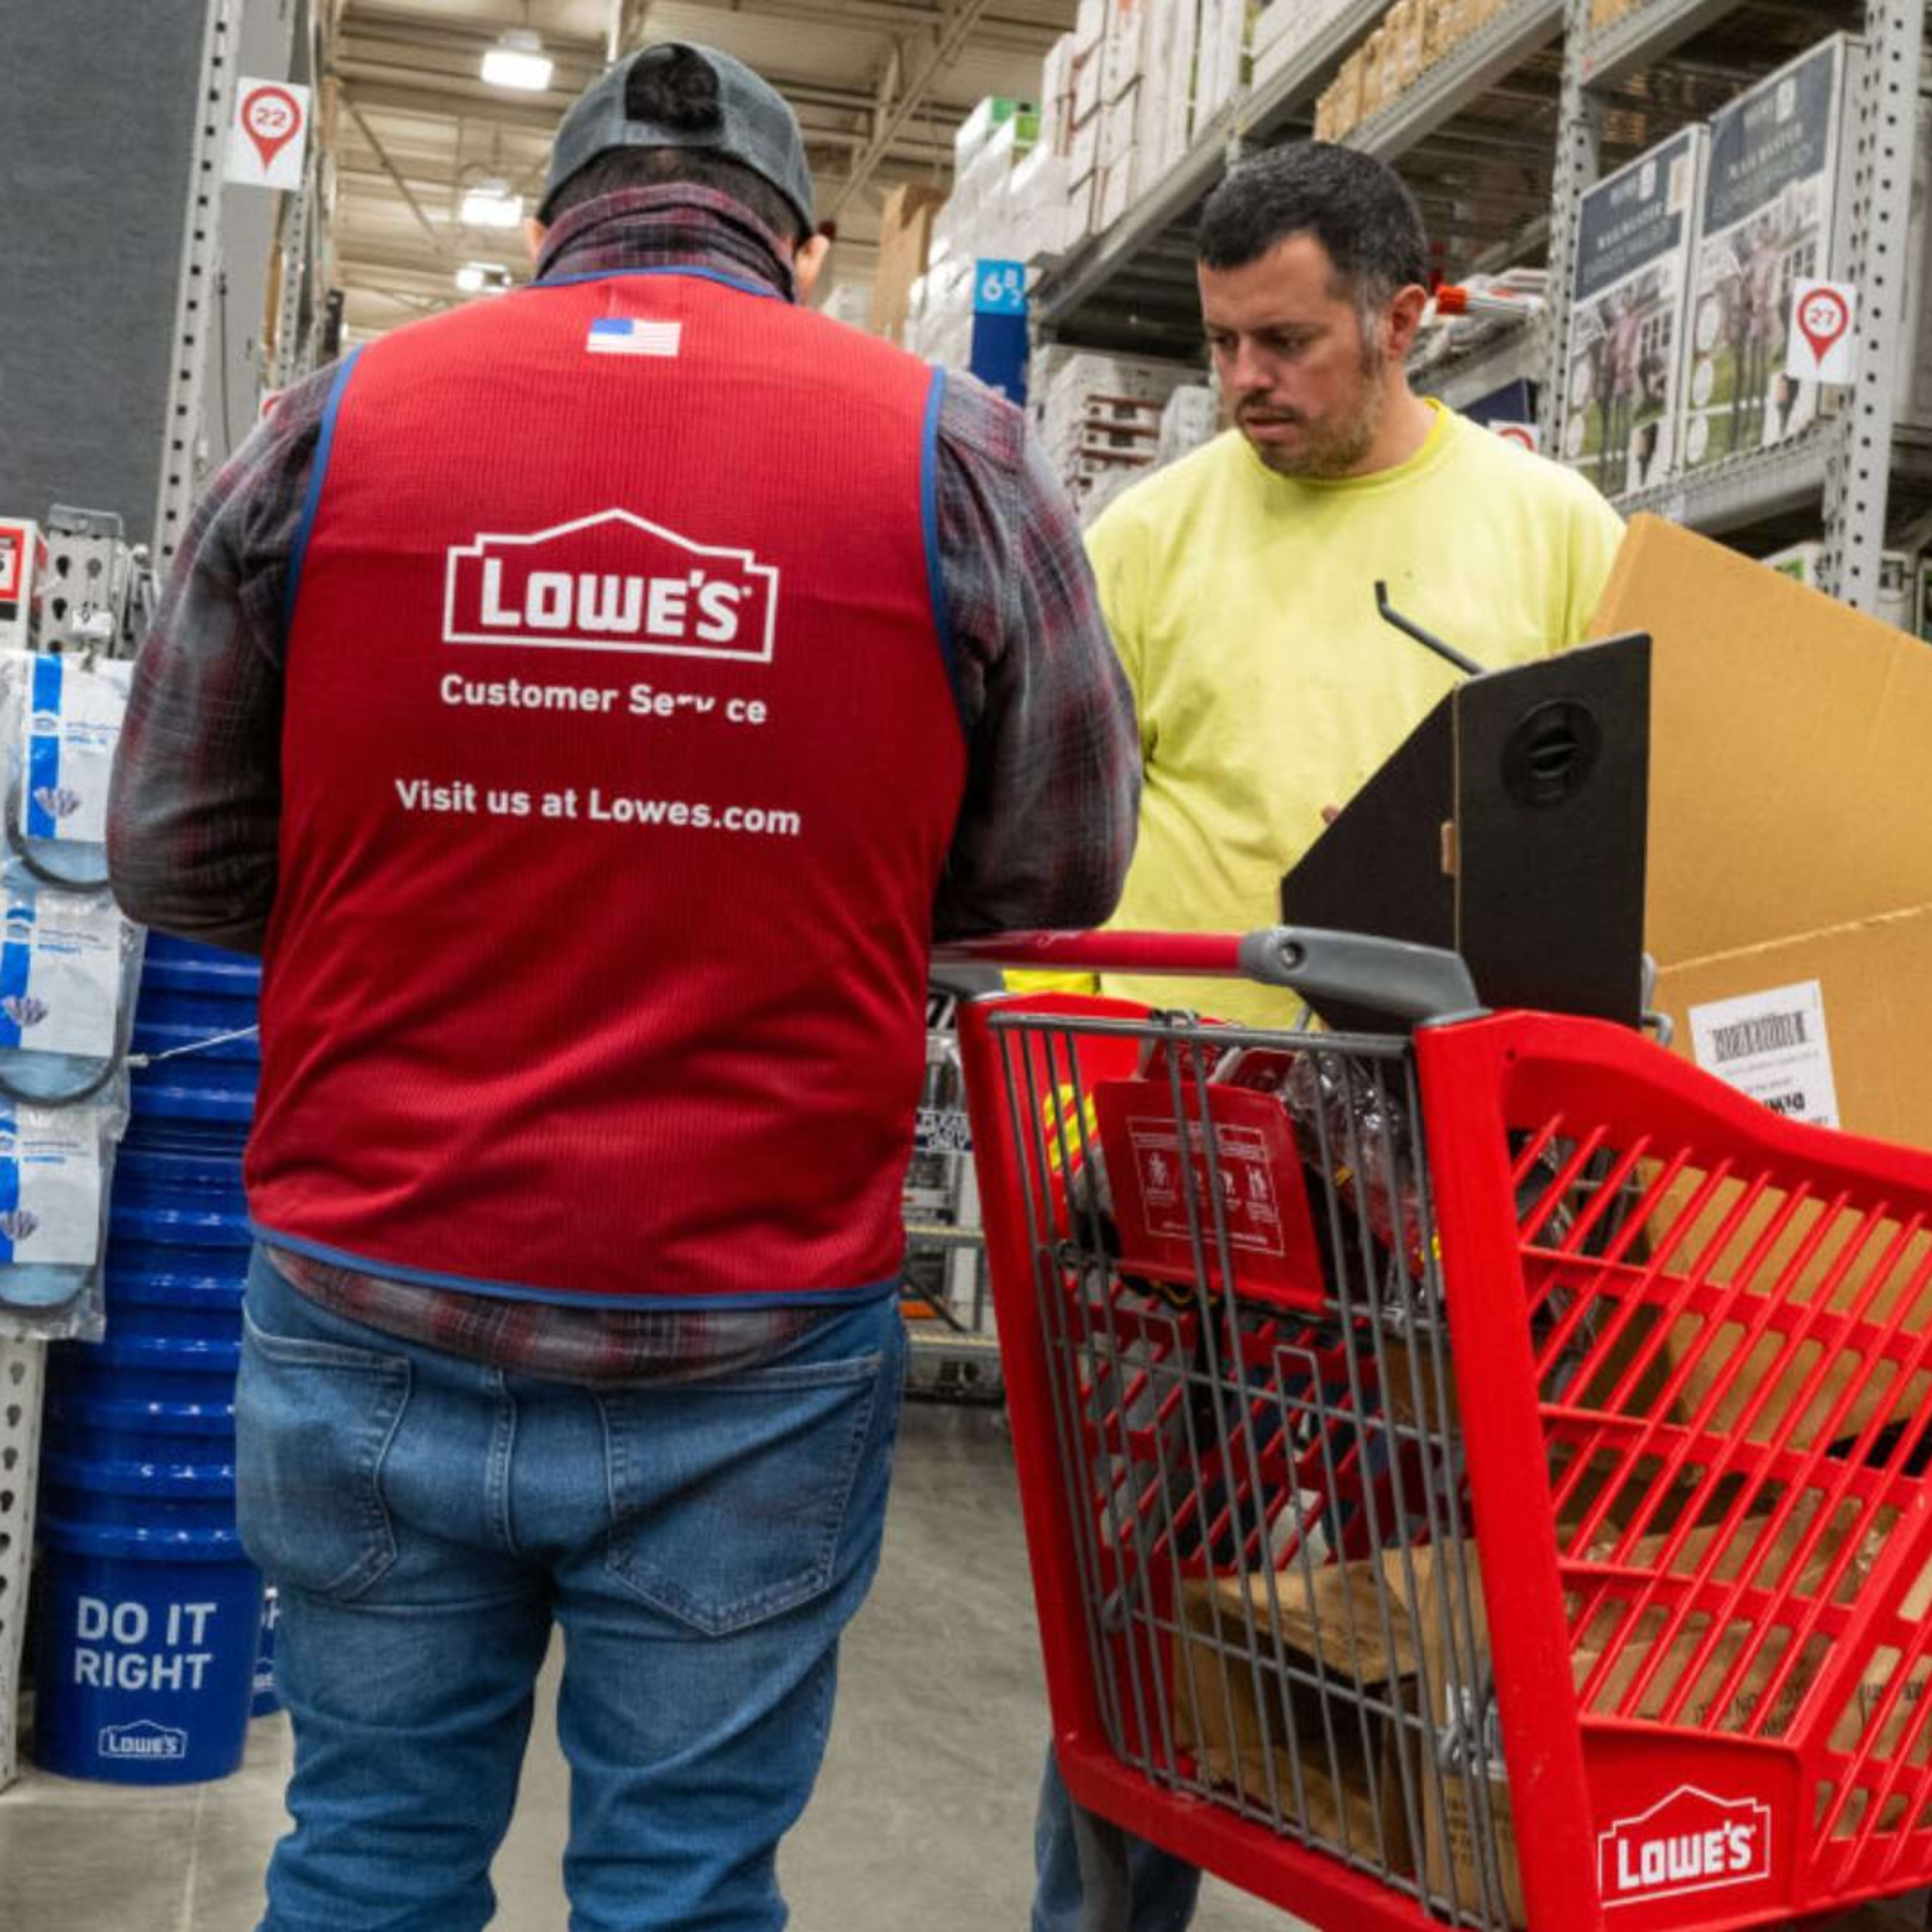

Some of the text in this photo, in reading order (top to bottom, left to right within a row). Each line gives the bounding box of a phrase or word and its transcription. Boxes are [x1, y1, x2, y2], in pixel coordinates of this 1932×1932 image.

[255, 107, 286, 128] 22
[1810, 307, 1835, 327] 27
[481, 558, 741, 641] LOWE'S
[441, 674, 767, 724] Customer Sevce
[395, 779, 801, 835] Visit us at Lowes.com
[77, 1596, 148, 1644] DO
[167, 1601, 217, 1646] IT
[75, 1649, 213, 1691] RIGHT
[1618, 1820, 1752, 1890] LOWE'S
